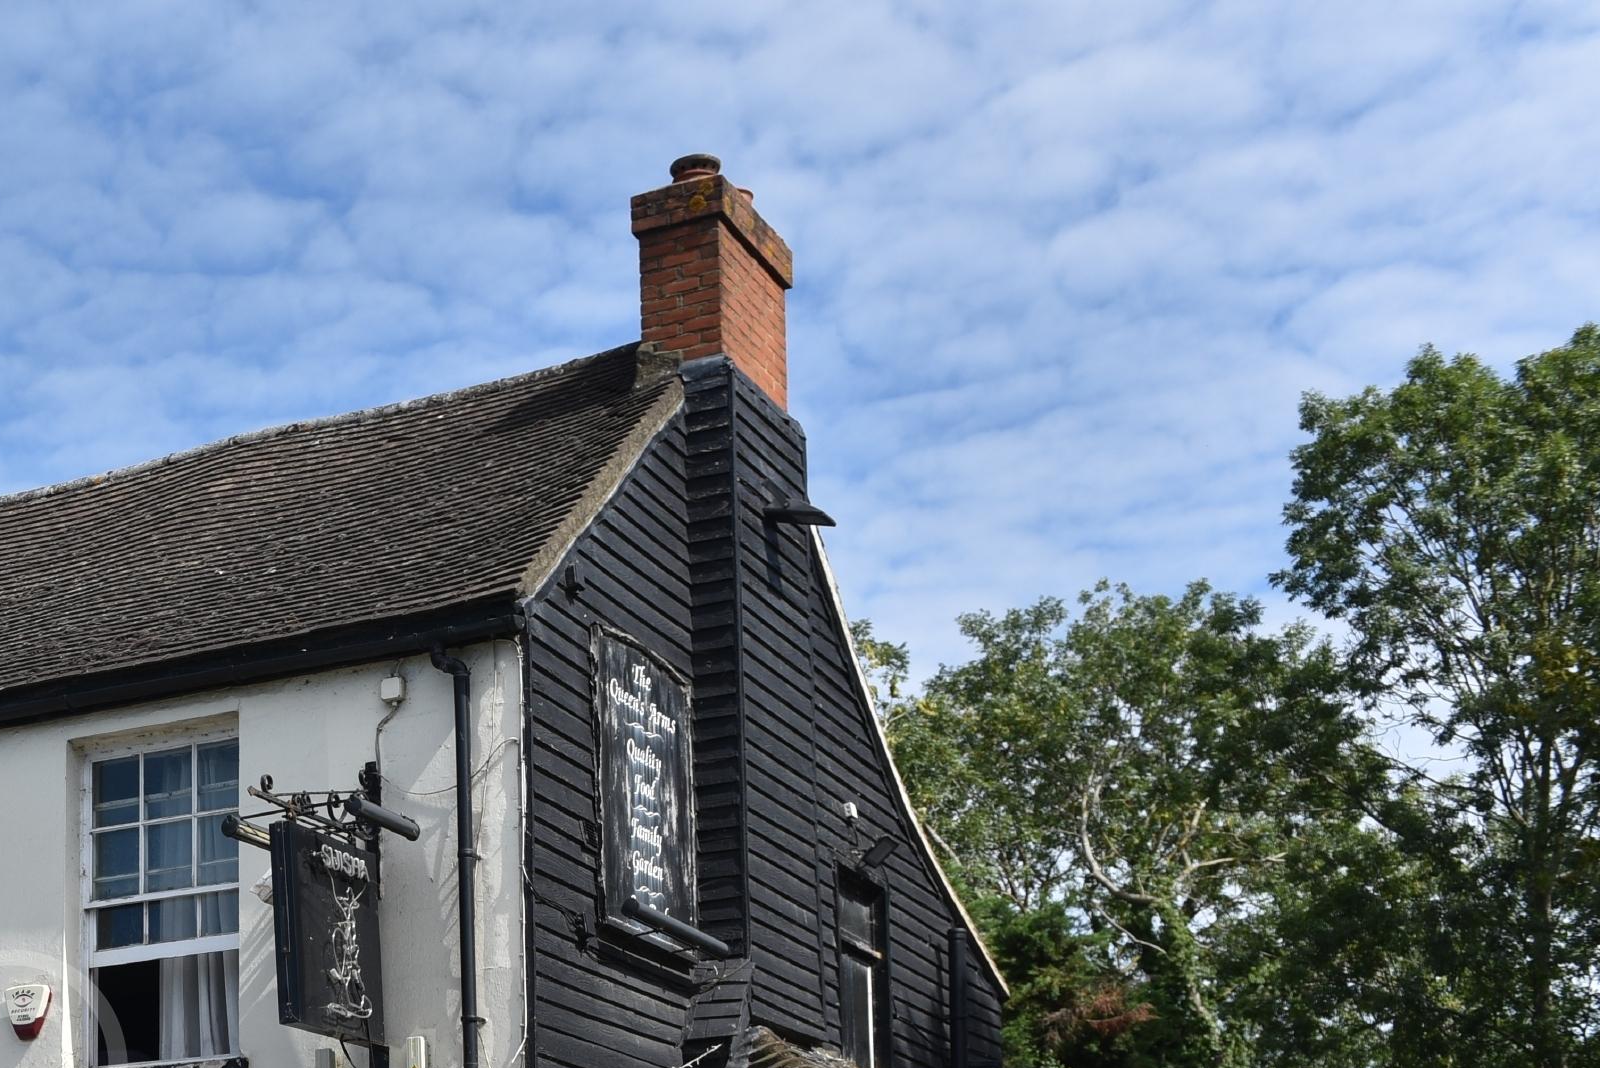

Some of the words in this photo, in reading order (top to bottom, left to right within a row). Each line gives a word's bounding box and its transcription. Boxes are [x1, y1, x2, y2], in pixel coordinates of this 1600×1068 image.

[632, 664, 652, 691] The
[610, 677, 645, 716] Queen's
[648, 702, 676, 734] Arms
[626, 738, 662, 780] Quality
[634, 774, 656, 800] Food
[631, 817, 663, 856] Family
[633, 850, 664, 881] Garden
